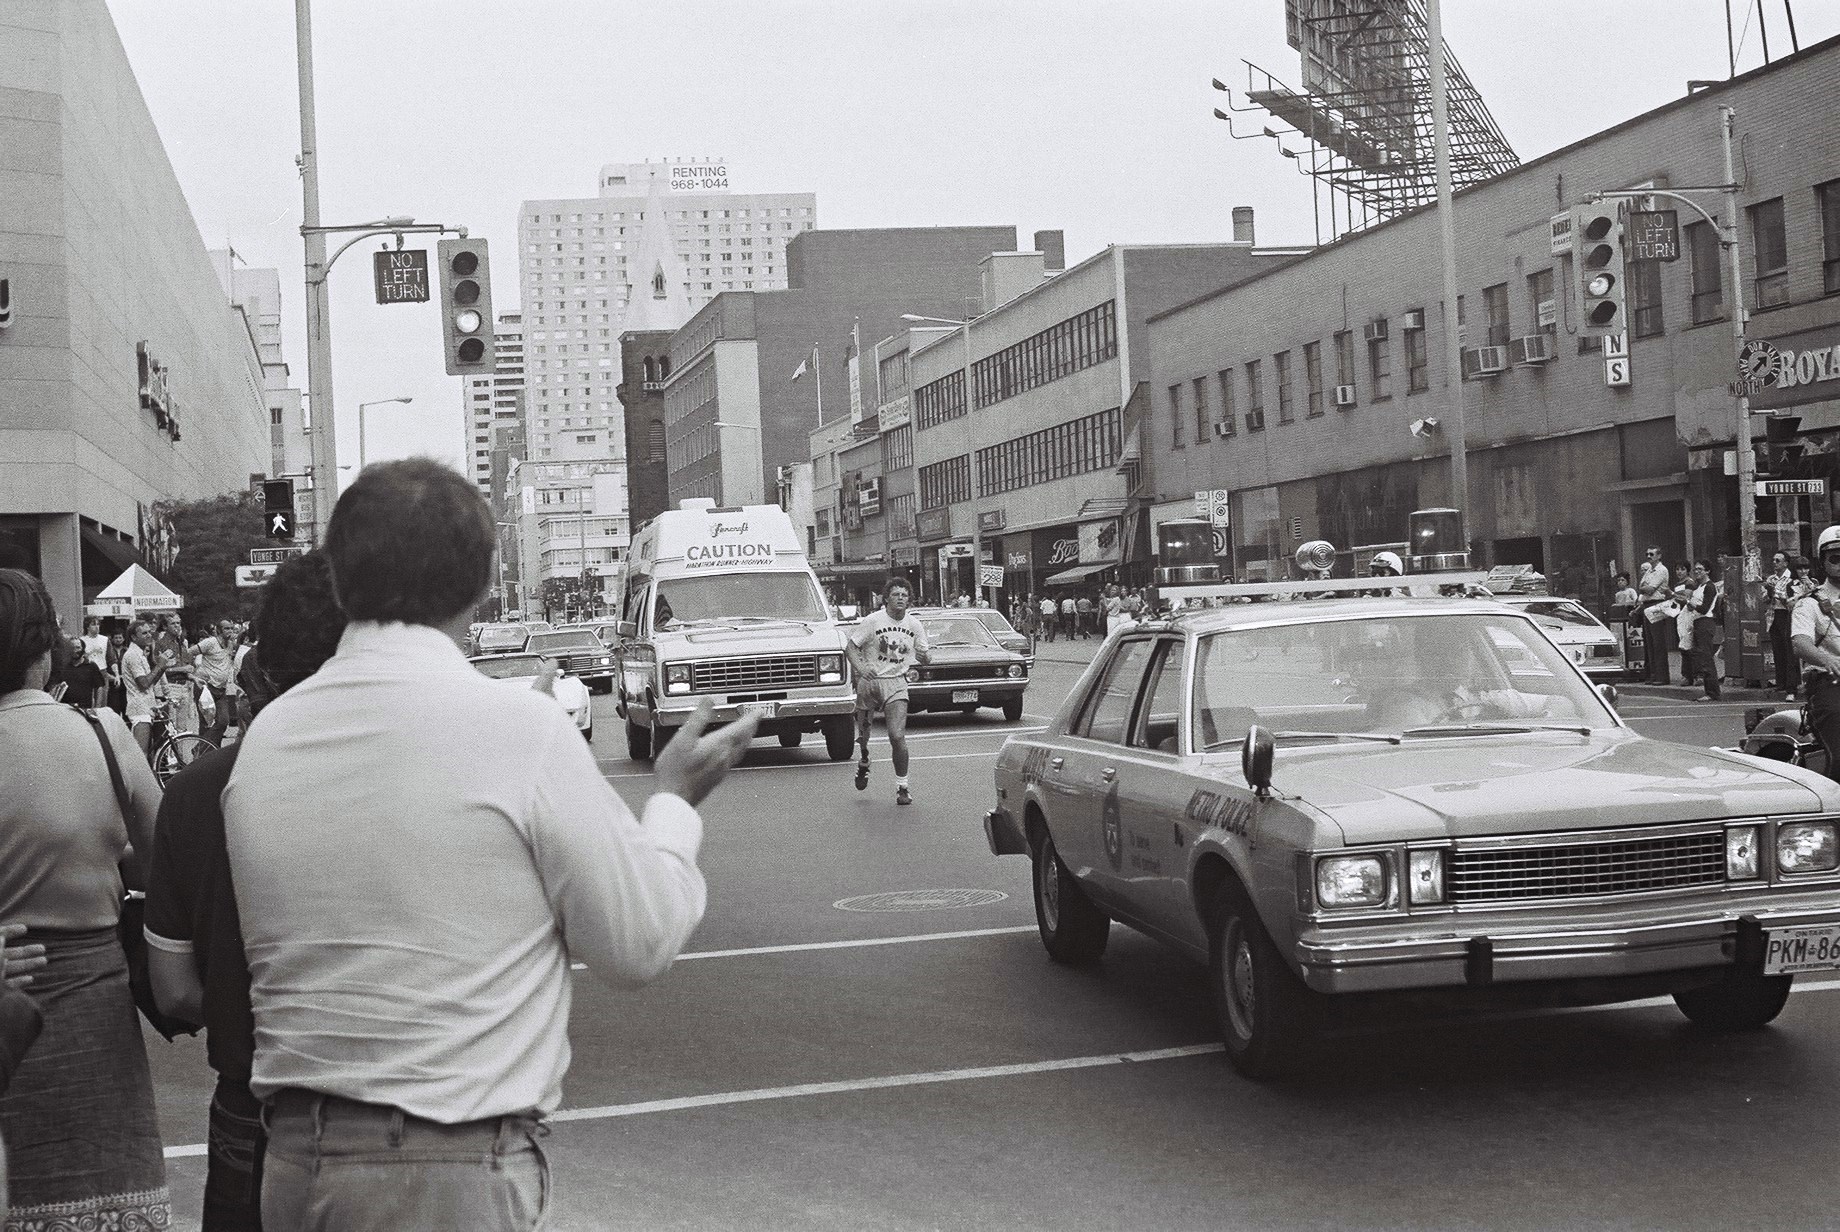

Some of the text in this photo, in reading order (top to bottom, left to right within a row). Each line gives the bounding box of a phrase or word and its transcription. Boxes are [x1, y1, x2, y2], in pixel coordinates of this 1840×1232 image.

[673, 166, 726, 177] RENTING
[671, 178, 728, 189] 968-1044
[1643, 213, 1664, 228] NO
[1636, 227, 1673, 243] LEFT
[1636, 242, 1675, 258] TURN
[390, 253, 413, 268] NO
[384, 268, 423, 284] LEFT
[382, 284, 425, 300] TURN
[1747, 342, 1781, 377] DON VALLEY
[1730, 381, 1760, 395] NORTH
[1769, 483, 1794, 493] YONGE
[1797, 483, 1808, 493] ST
[252, 551, 273, 562] YONGE
[275, 551, 284, 561] ST
[686, 544, 771, 560] CAUTION
[134, 597, 178, 607] INFORMATION
[875, 626, 915, 638] MARATHON
